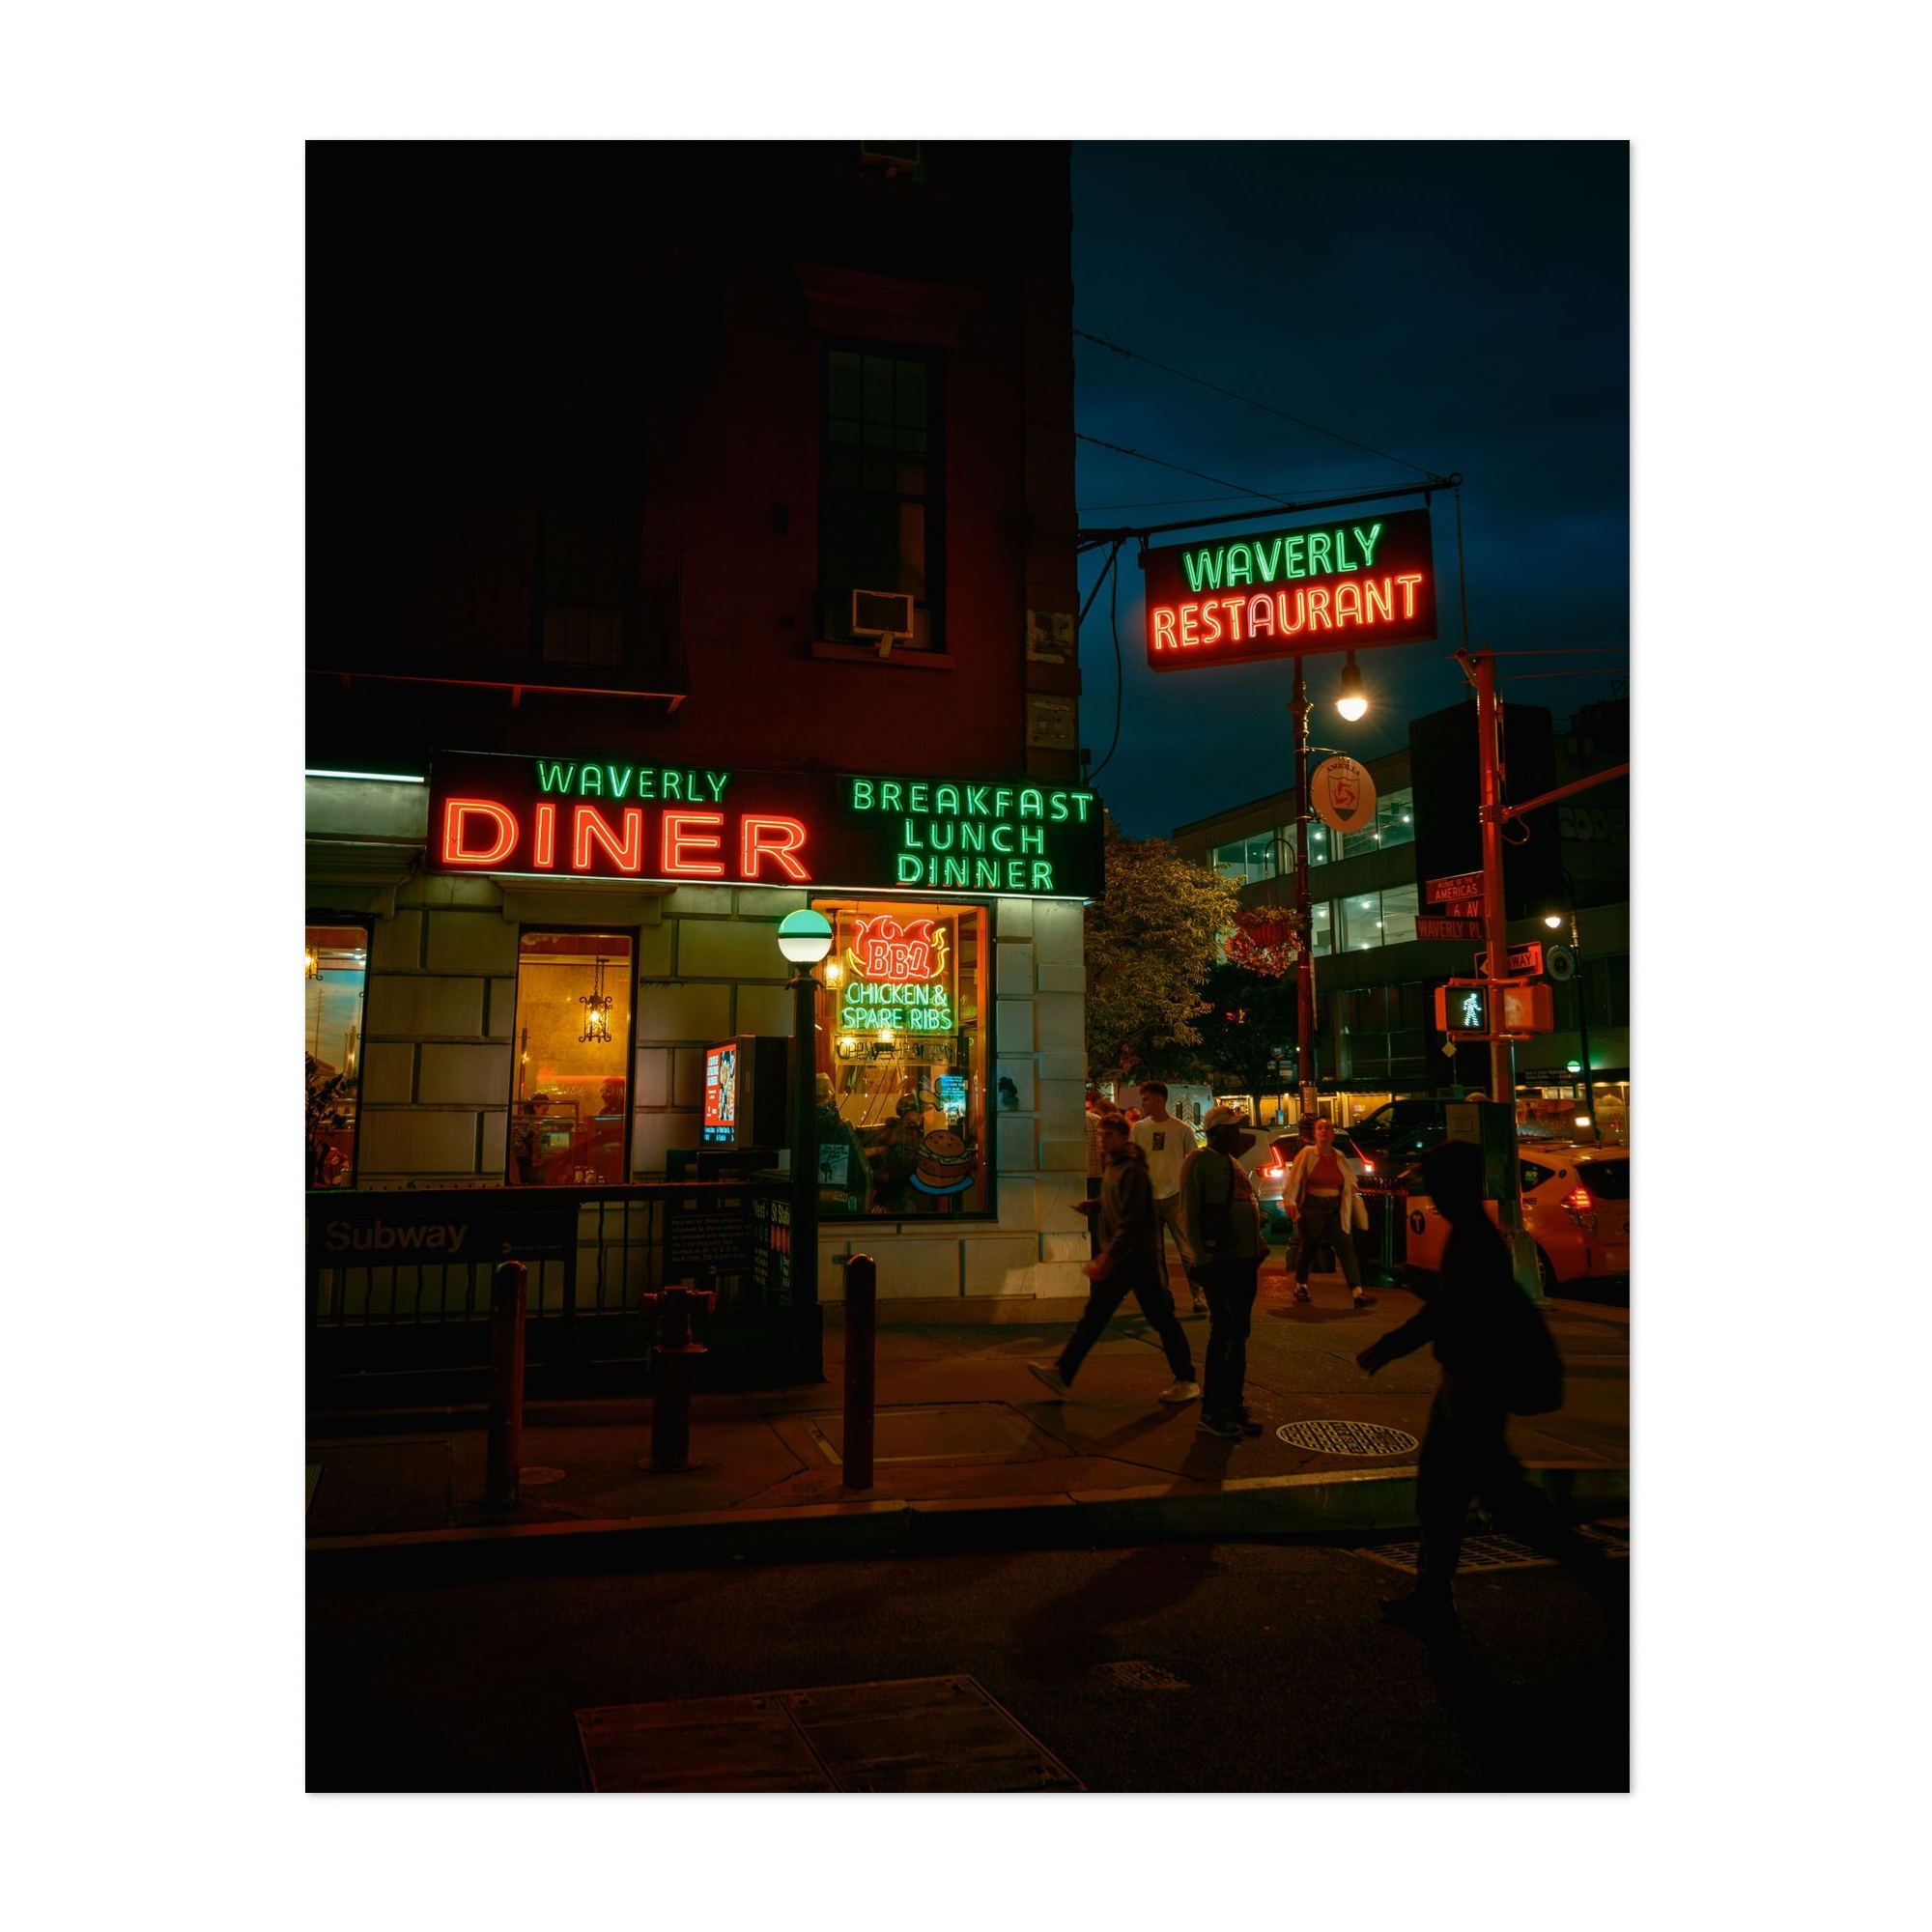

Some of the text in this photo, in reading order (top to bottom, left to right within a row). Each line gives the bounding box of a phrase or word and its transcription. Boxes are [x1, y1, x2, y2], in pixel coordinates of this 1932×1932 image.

[1183, 524, 1381, 592] WAVERLY
[1153, 574, 1423, 650] RESTAURANT
[537, 759, 728, 803] WAVERLY
[853, 780, 1094, 822] BREAKFAST
[441, 797, 811, 880] DINER
[904, 818, 1046, 855] LUNCH
[897, 854, 1054, 891] DINNER
[1435, 884, 1478, 900] AMERICAS
[1467, 900, 1479, 917] AV
[1418, 920, 1483, 938] WAVERLY PL
[867, 939, 929, 980] BBQ
[1511, 953, 1532, 969] WAY
[845, 982, 948, 1007] CHICKEN &
[841, 1008, 952, 1030] SPARE RIBS
[325, 1217, 469, 1253] Subway
